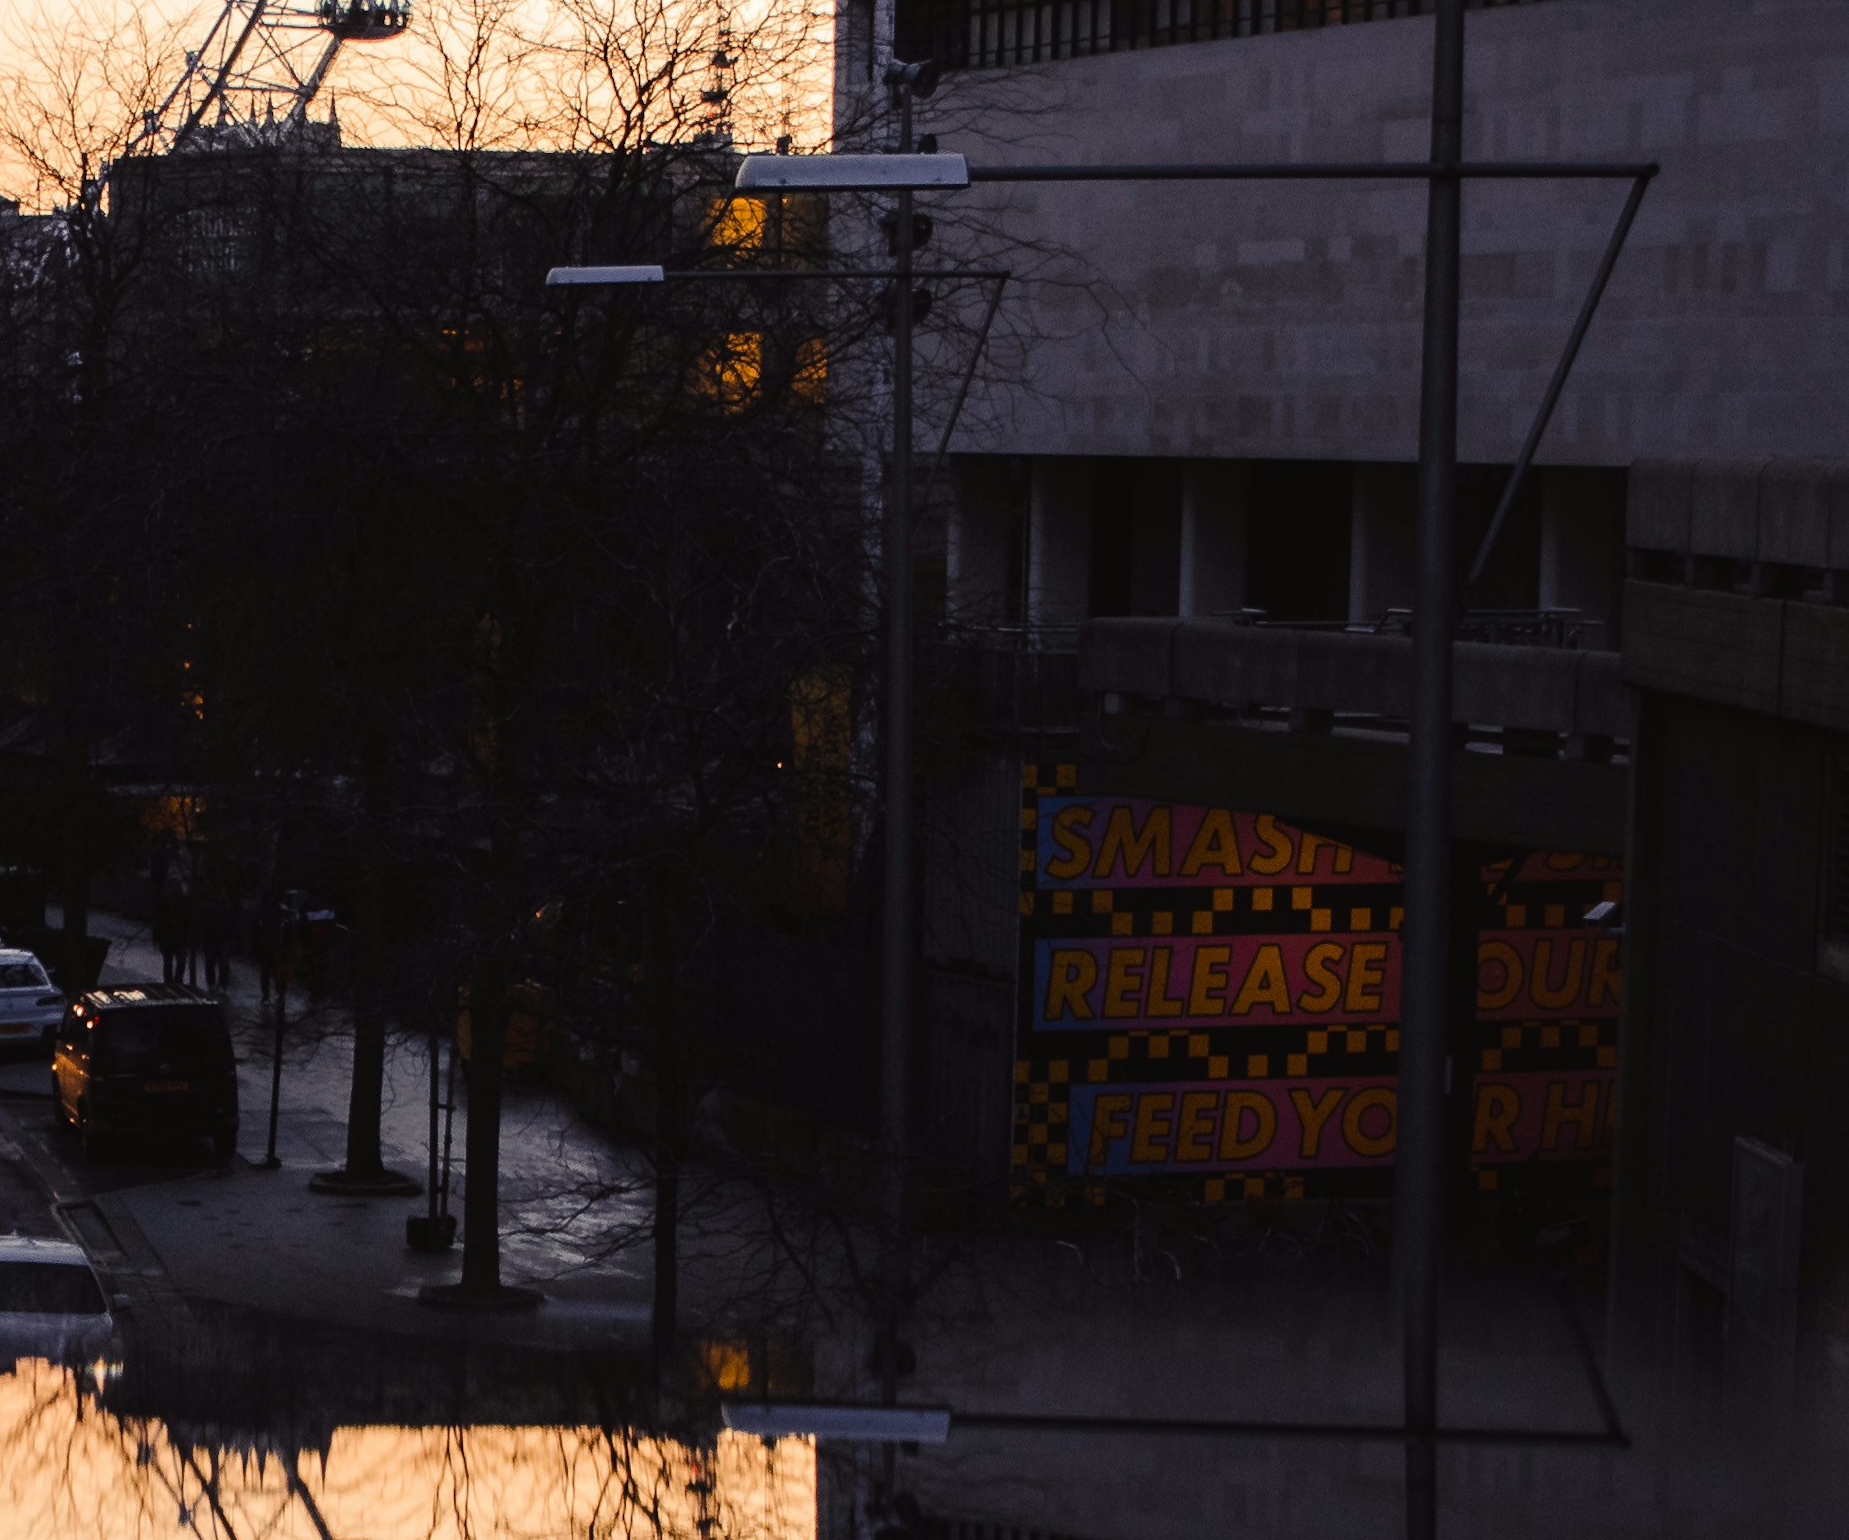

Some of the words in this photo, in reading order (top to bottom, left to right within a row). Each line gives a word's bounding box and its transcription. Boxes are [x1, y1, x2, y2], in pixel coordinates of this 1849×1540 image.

[1043, 940, 1390, 1021] RELEASE
[1475, 936, 1623, 1011] OUR
[1089, 1087, 1278, 1166] FEED
[1286, 1081, 1521, 1160] YOR
